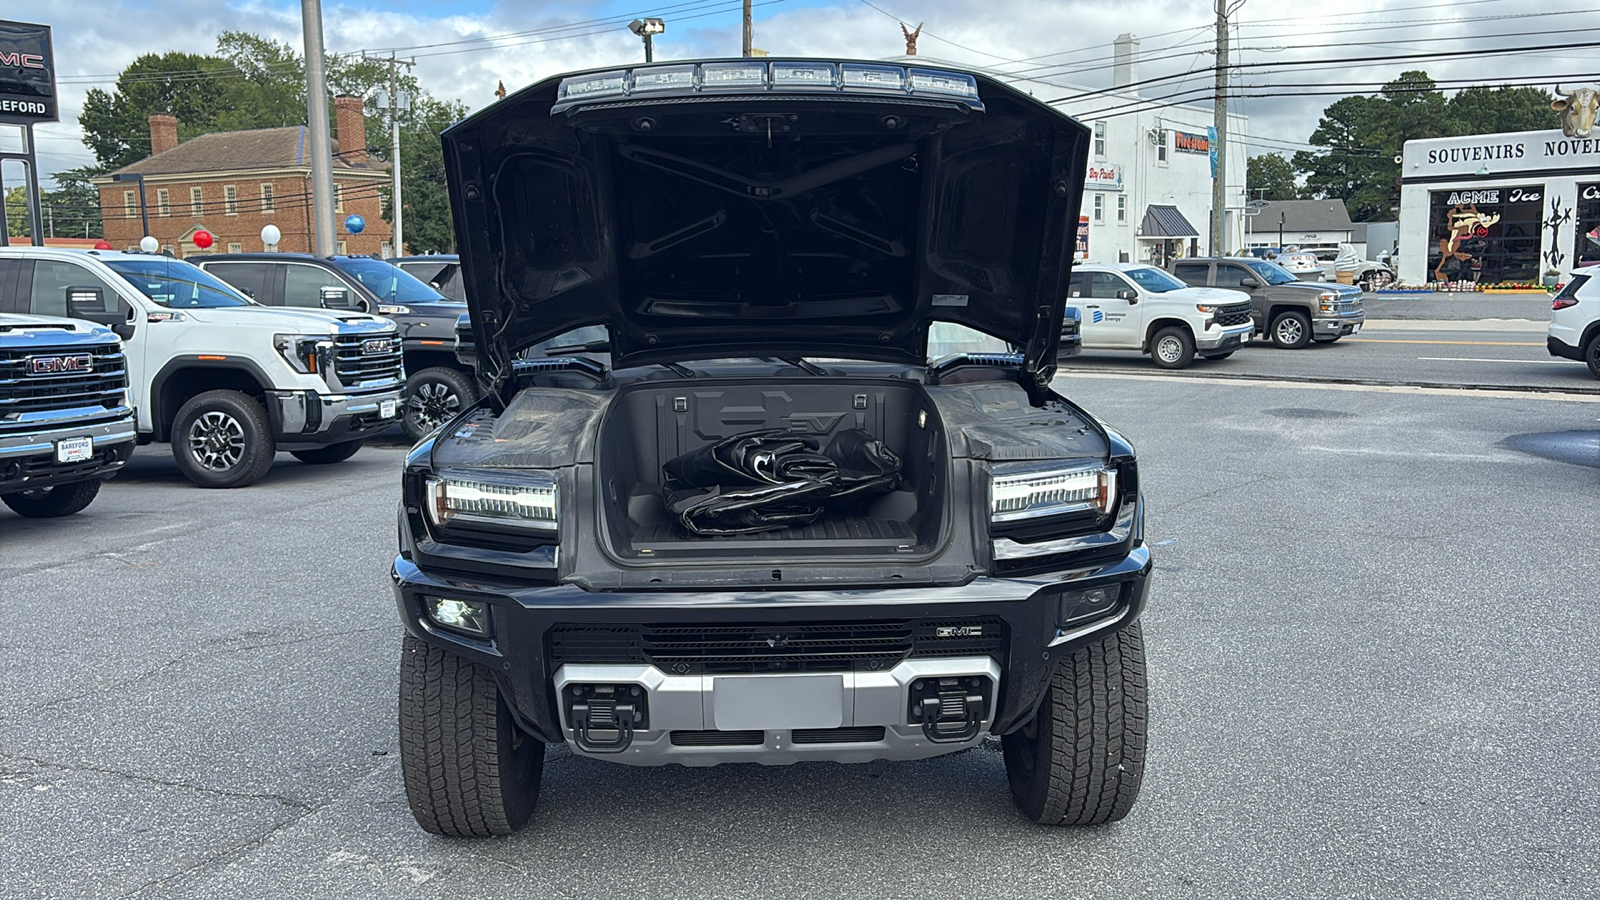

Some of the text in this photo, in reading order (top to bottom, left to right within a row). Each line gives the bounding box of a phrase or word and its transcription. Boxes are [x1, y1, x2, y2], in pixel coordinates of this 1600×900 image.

[0, 100, 45, 114] EFORD
[1428, 143, 1525, 164] SOUVENIRS
[1089, 167, 1099, 181] Boy
[1447, 190, 1499, 205] ACME
[1509, 188, 1541, 202] Ice
[34, 356, 91, 373] GMC
[61, 441, 89, 450] BAREFORD
[936, 626, 982, 637] GMC
